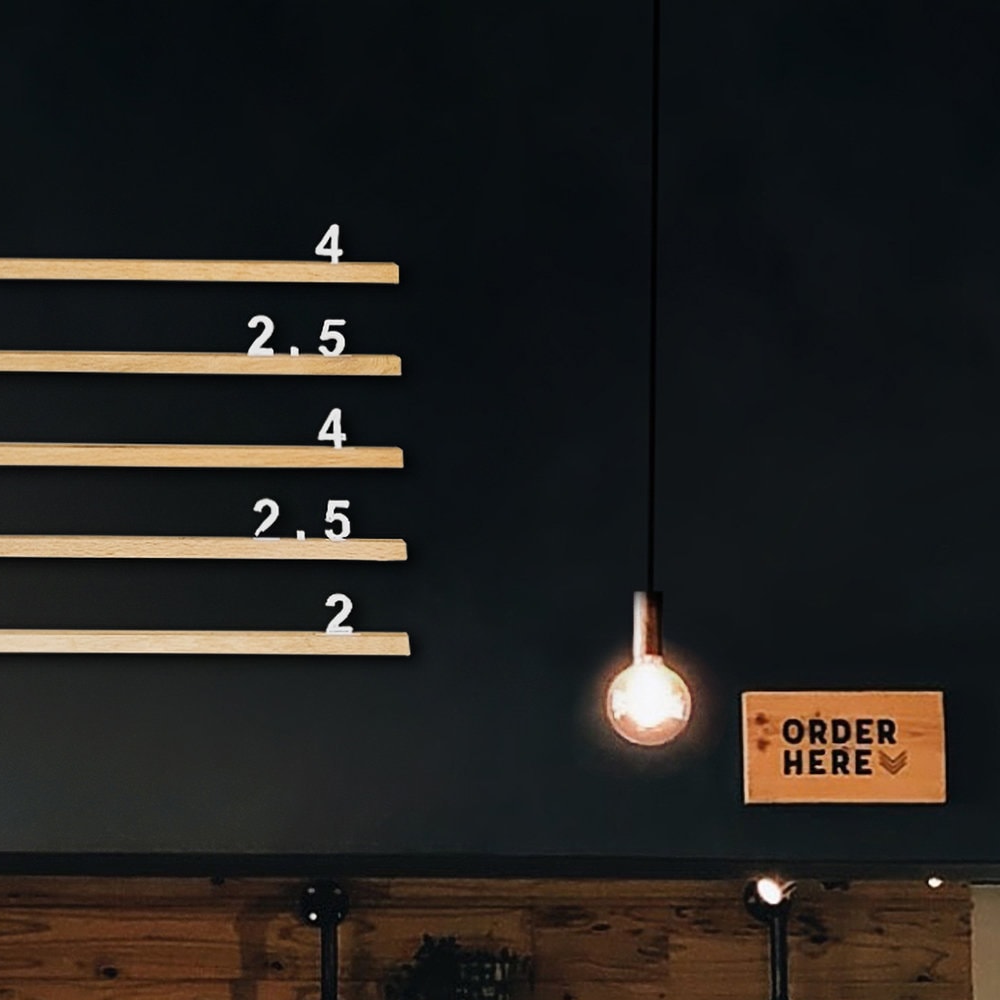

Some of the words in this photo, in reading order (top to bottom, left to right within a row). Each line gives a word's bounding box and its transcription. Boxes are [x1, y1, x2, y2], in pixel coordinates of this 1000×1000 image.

[314, 223, 344, 265] 4
[247, 314, 347, 357] 2.5
[317, 407, 347, 450] 4
[252, 497, 351, 541] 2.5
[324, 593, 354, 635] 2
[782, 718, 896, 745] ORDER
[783, 749, 873, 775] HERE
